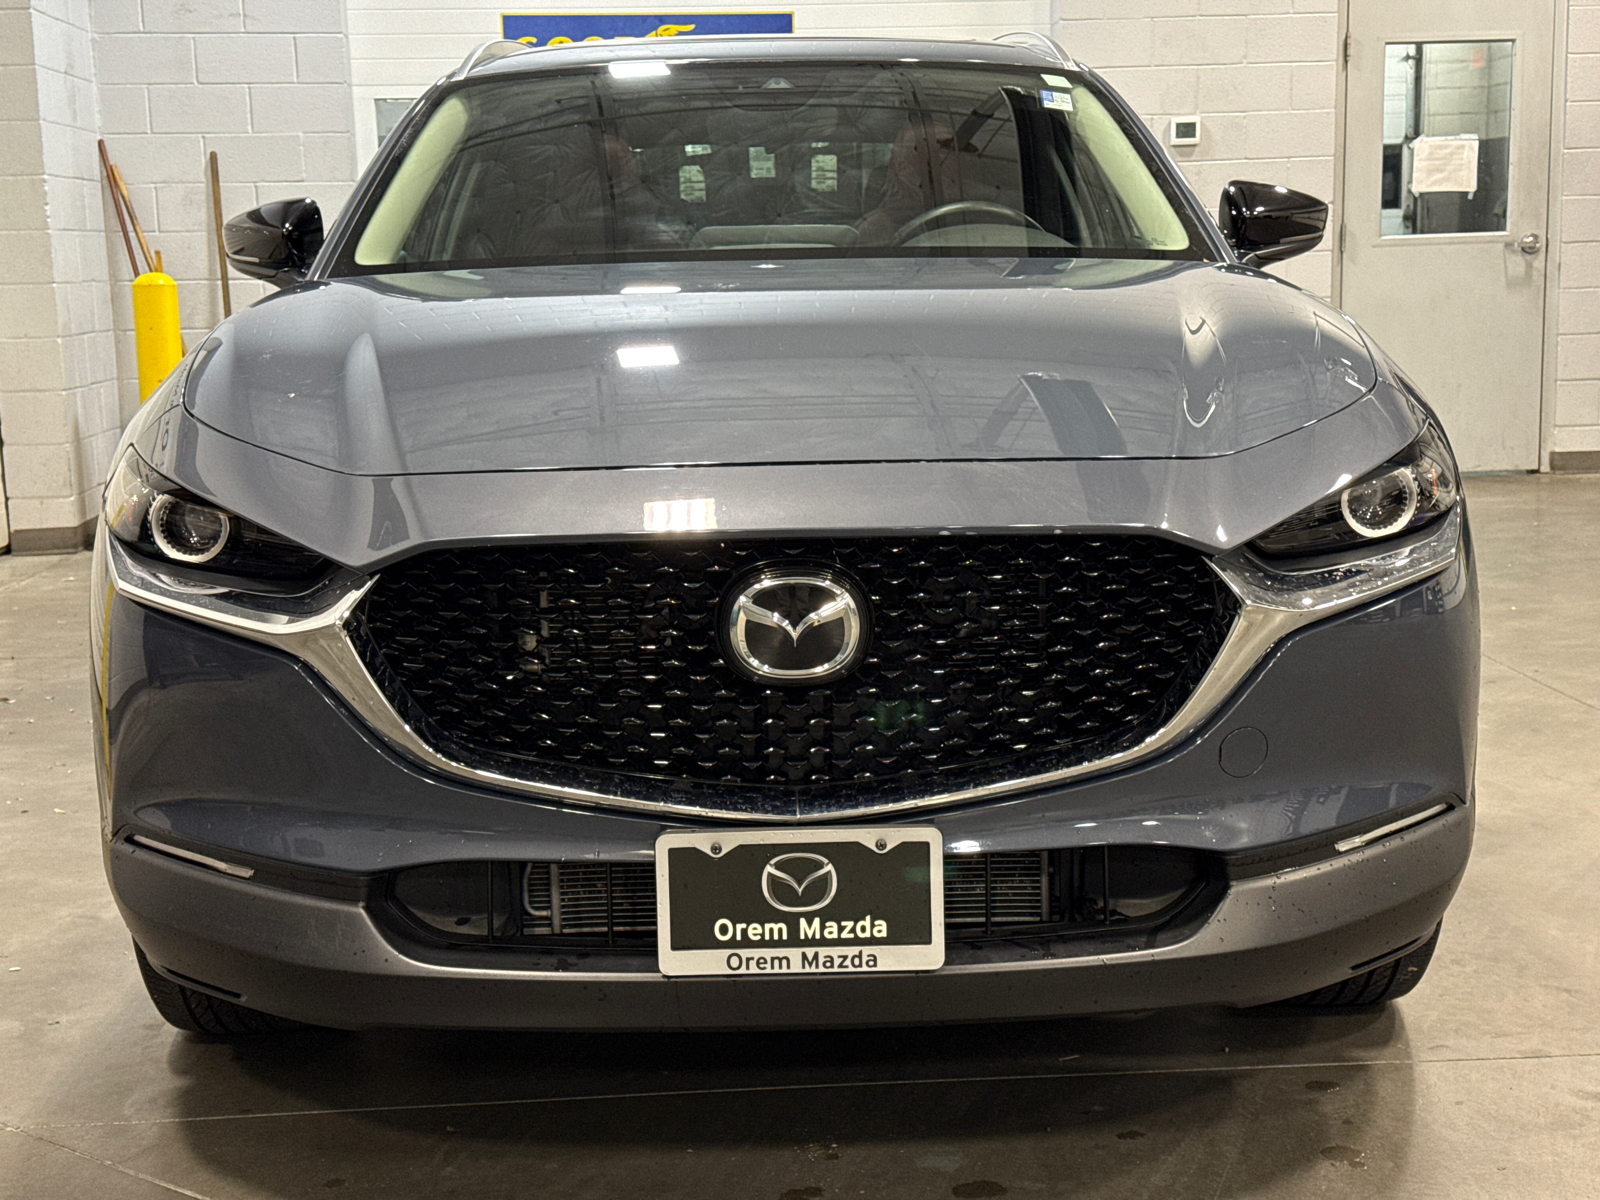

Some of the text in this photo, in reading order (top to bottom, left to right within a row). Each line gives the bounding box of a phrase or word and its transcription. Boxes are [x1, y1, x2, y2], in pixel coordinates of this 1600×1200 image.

[714, 915, 887, 940] Orem Mazda
[726, 949, 878, 971] Orem Mazda
